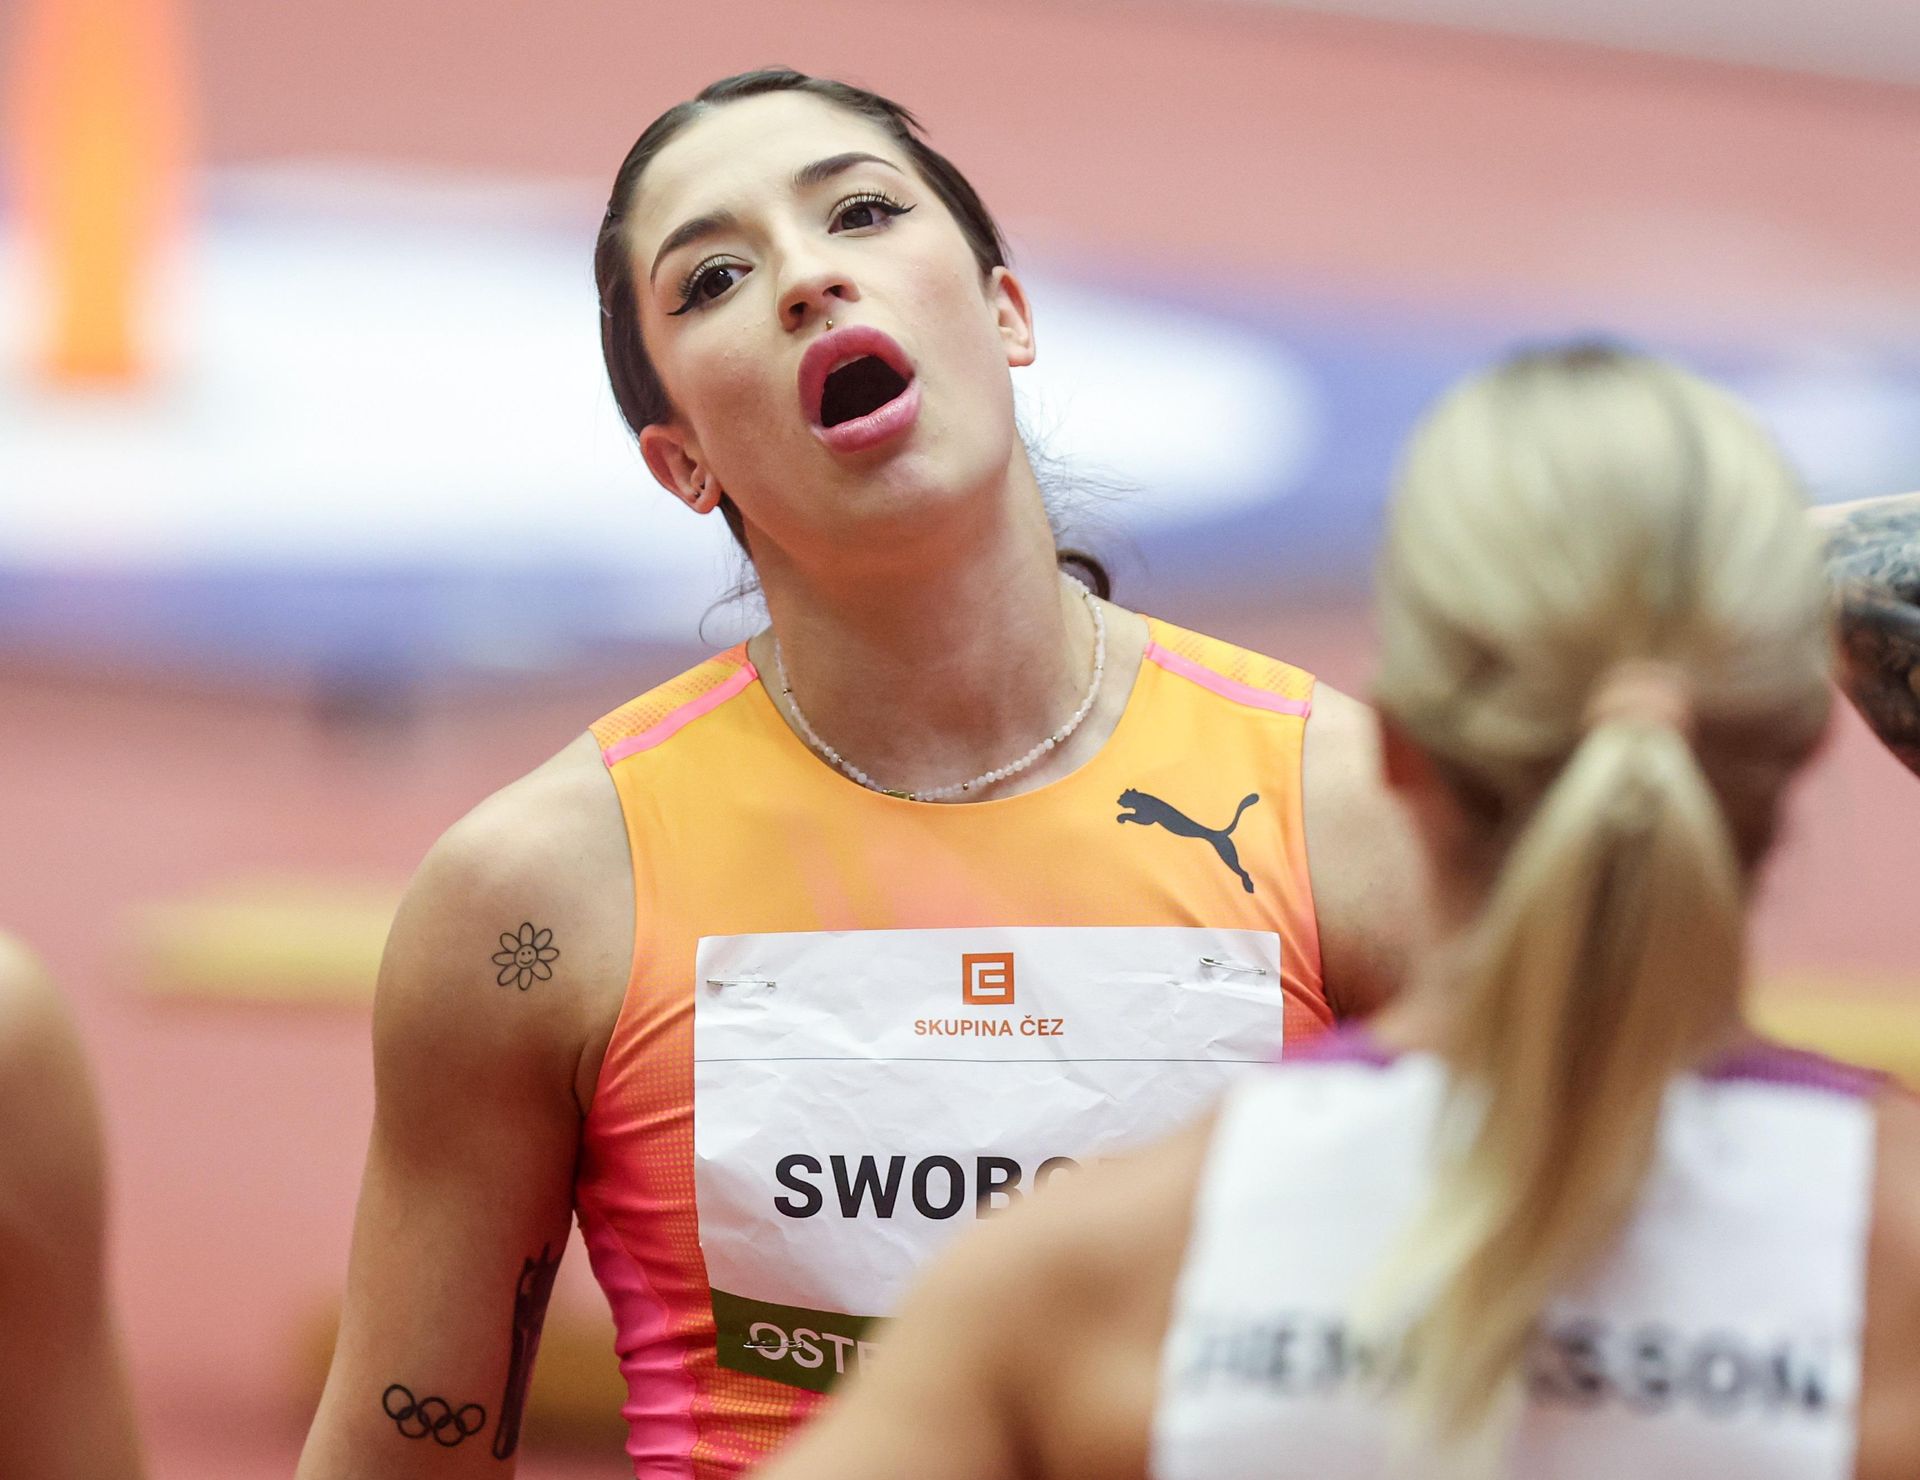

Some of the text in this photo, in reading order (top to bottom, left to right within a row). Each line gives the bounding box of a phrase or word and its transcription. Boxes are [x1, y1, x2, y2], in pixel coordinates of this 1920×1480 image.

[914, 1014, 1065, 1037] SKUPINA ČEZ
[774, 1153, 1130, 1220] SWOB
